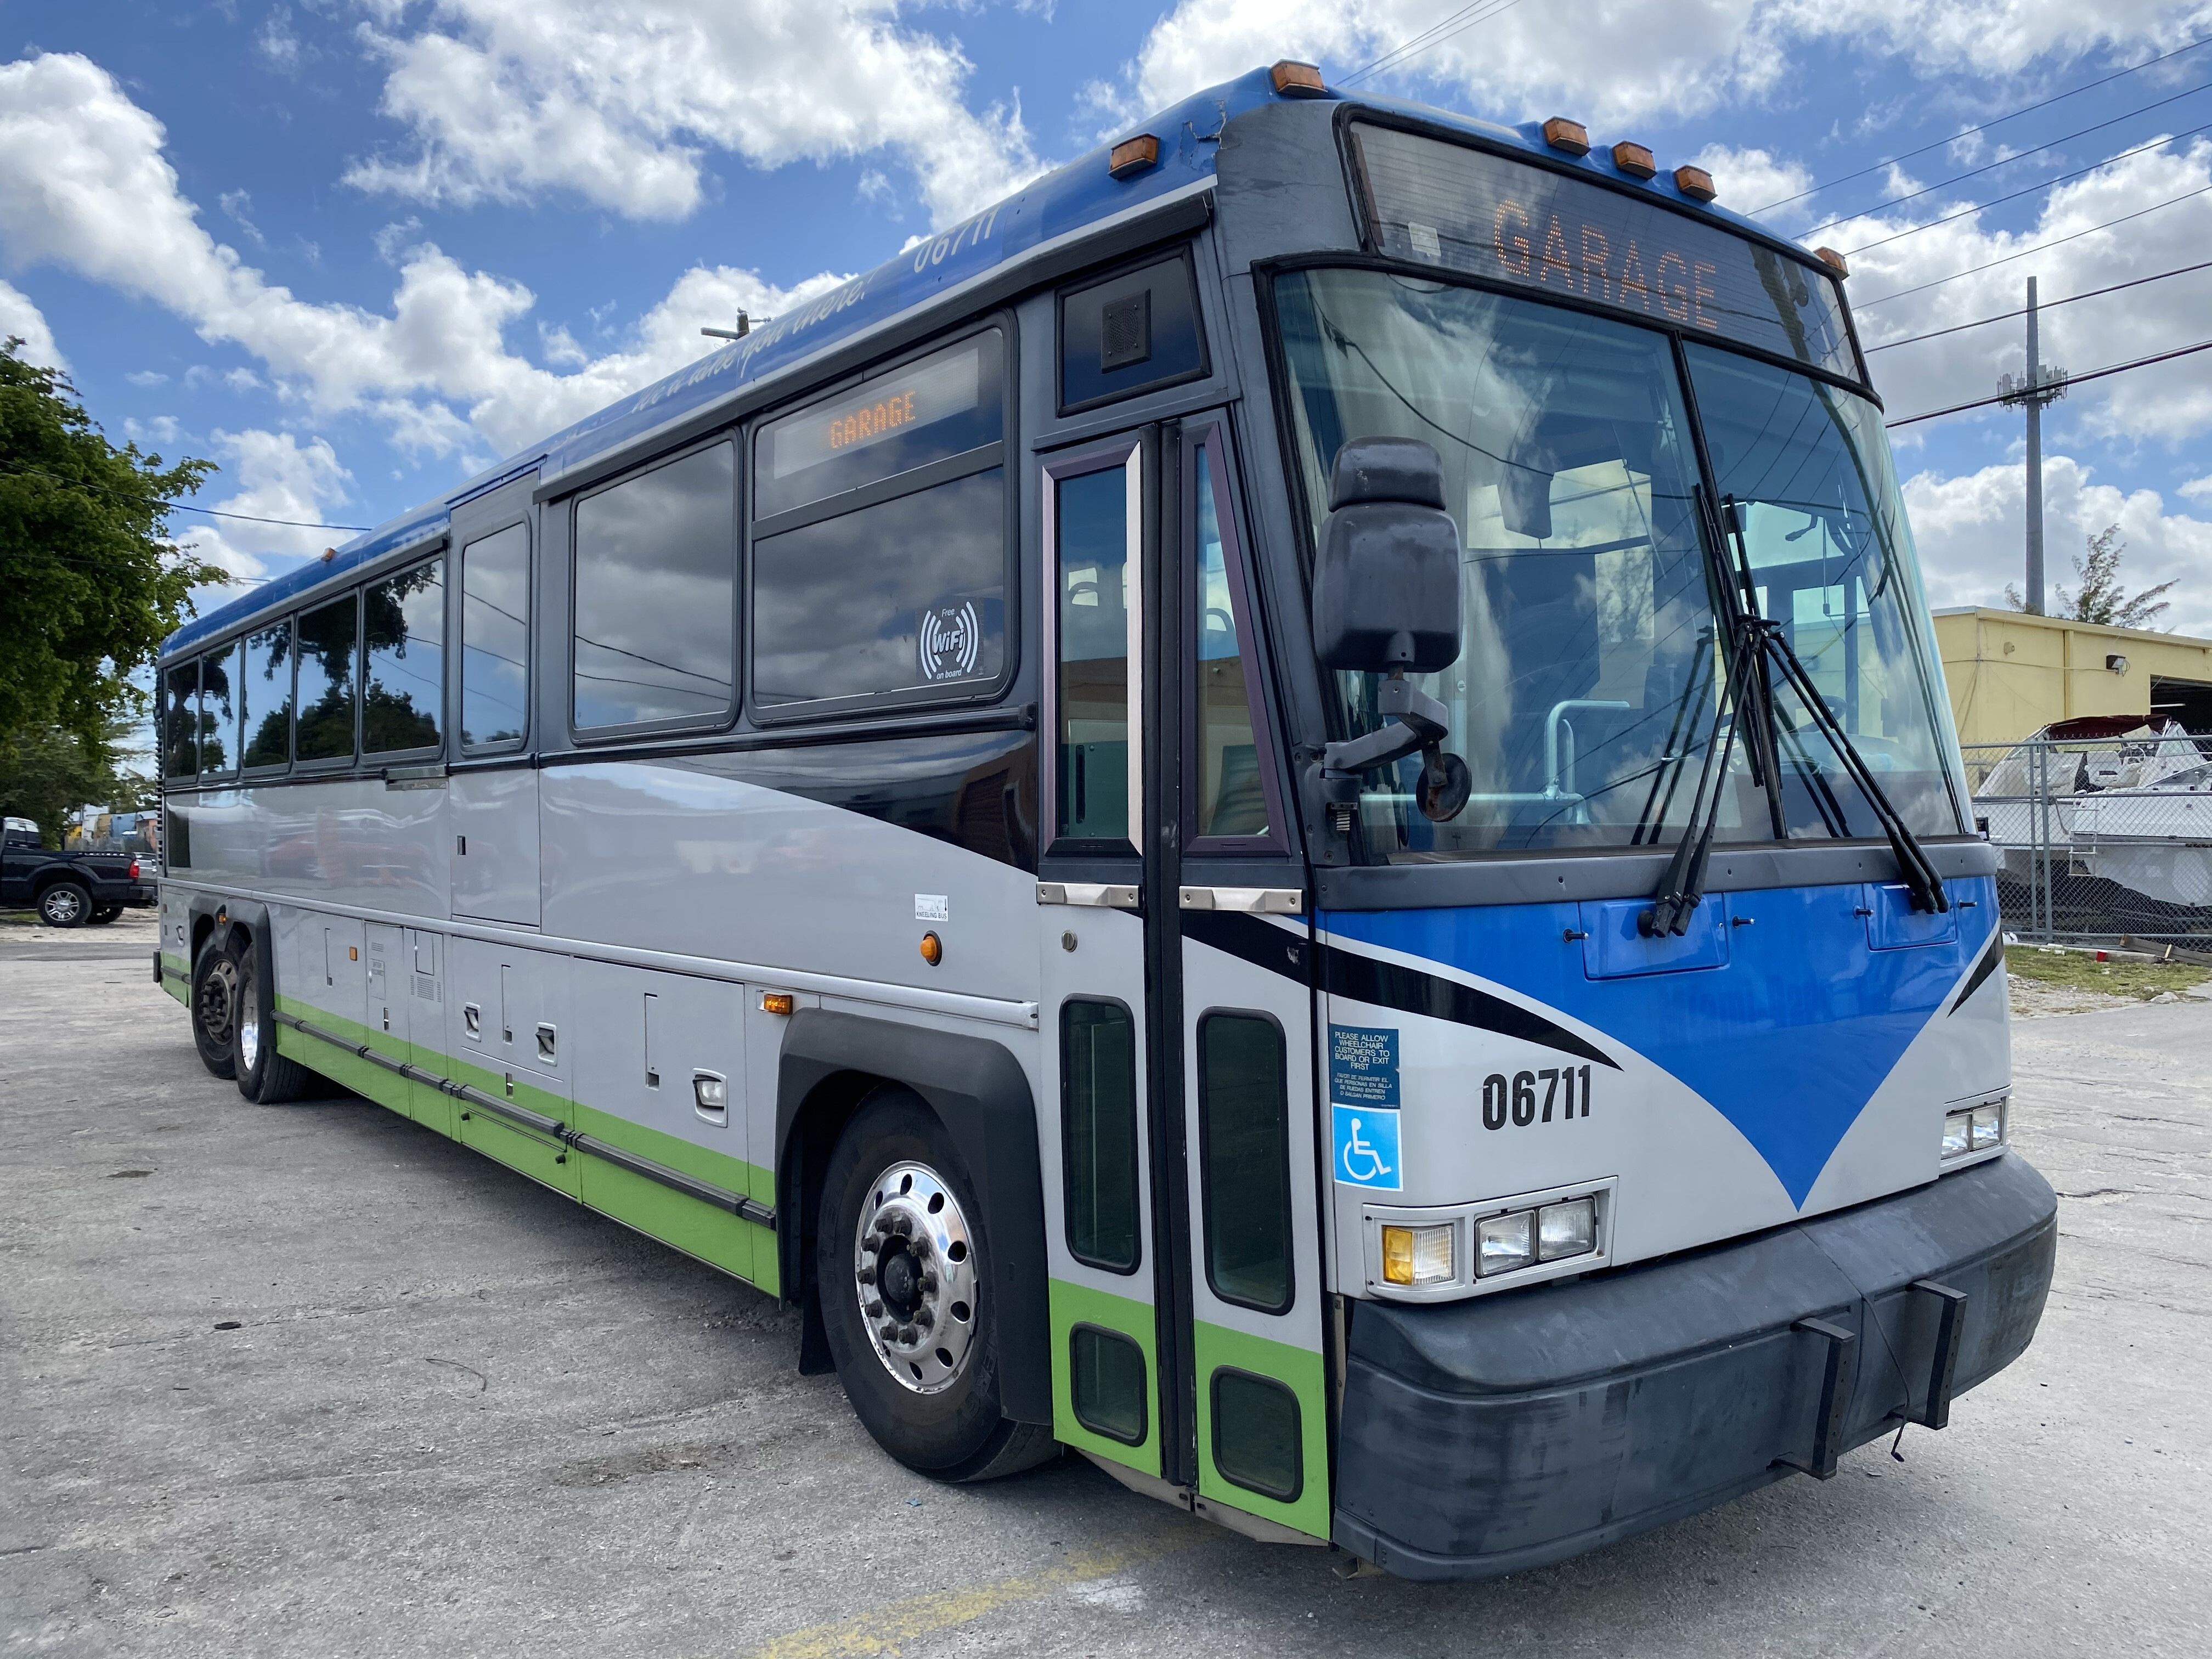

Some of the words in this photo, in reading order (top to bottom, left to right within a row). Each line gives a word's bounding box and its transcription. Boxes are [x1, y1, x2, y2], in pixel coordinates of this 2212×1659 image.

[914, 208, 1000, 273] 06711
[1494, 200, 1718, 329] GARAGE
[831, 391, 917, 449] GARAGE
[941, 608, 955, 617] Free
[933, 628, 964, 653] WiFi
[945, 668, 962, 678] board
[1335, 1031, 1358, 1040] PLEASE
[1339, 1039, 1384, 1049] WHEELCHAIR
[1335, 1046, 1376, 1057] CUSTOMERS
[1335, 1053, 1356, 1062] BOARD
[1351, 1062, 1369, 1070] FIRST
[1482, 1064, 1590, 1130] 06711
